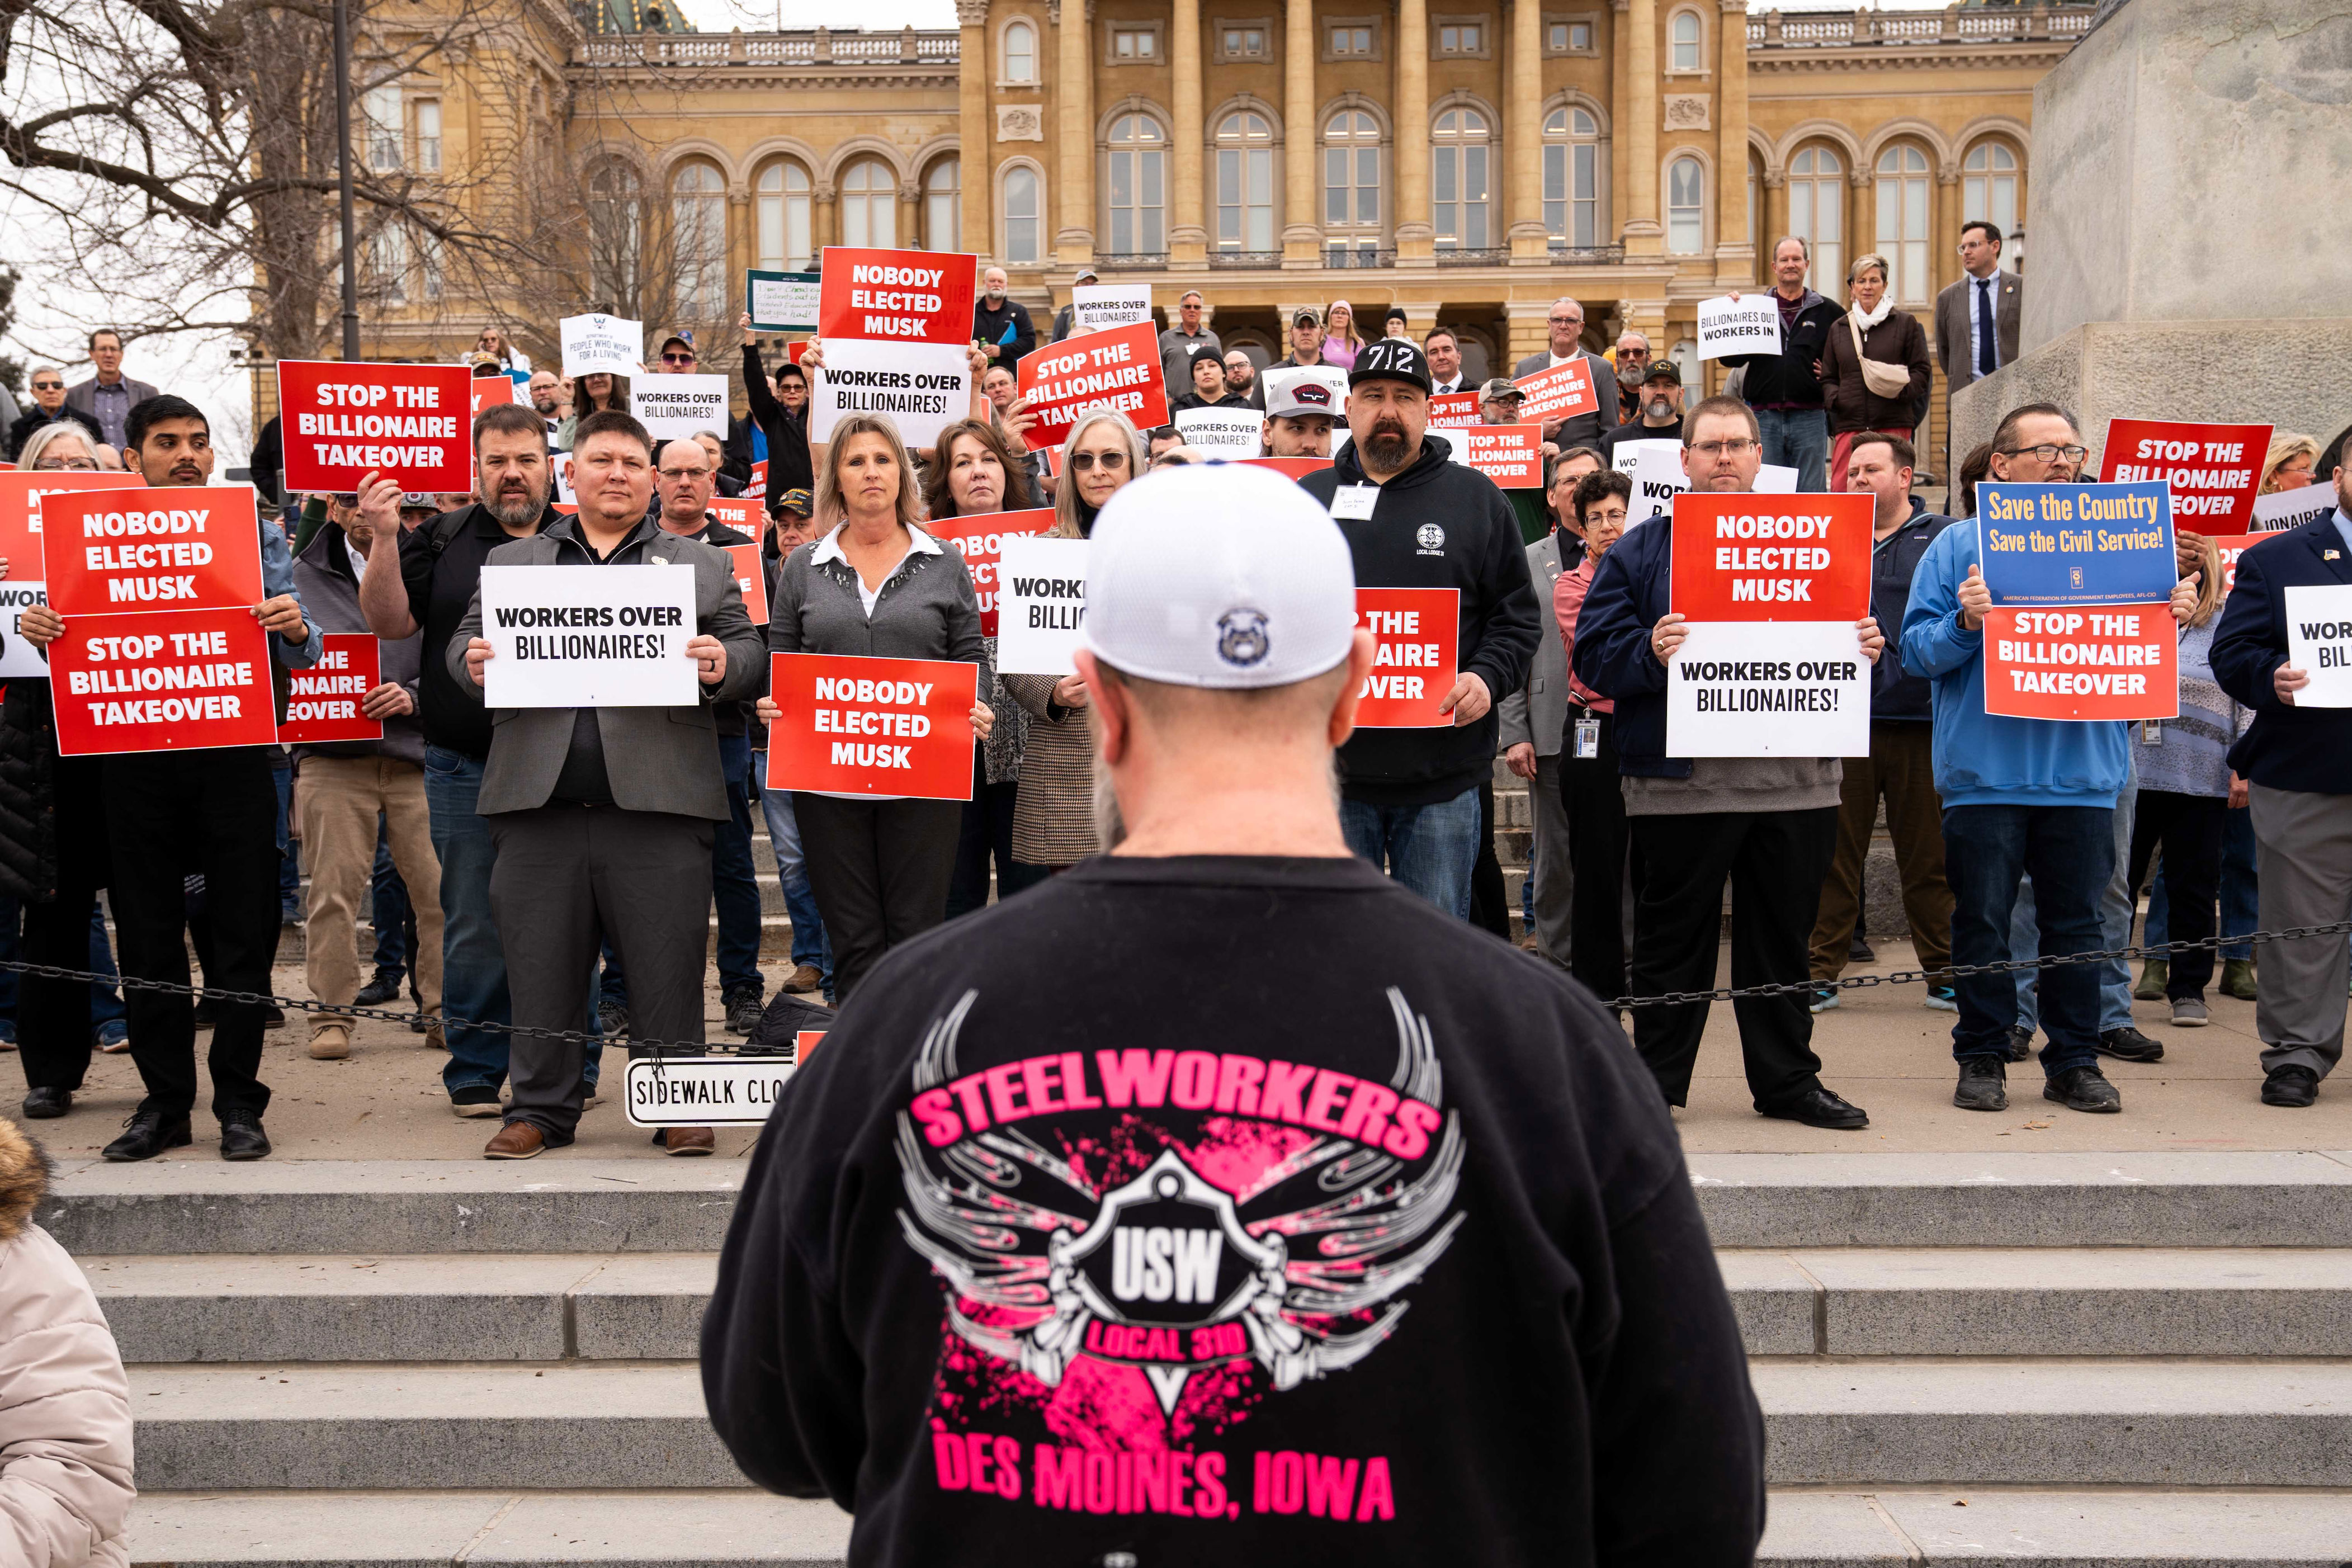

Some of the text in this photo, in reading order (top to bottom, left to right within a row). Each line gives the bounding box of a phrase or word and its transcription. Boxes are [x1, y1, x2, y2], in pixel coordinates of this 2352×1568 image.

[853, 265, 943, 287] NOBODY
[852, 290, 941, 312] ELECTED
[1079, 302, 1120, 310] WORKERS
[865, 315, 927, 336] MUSK
[1084, 311, 1140, 324] BILLIONAIRES!
[1701, 311, 1774, 328] BILLIONAIRES OUT
[1704, 326, 1773, 341] WORKERS IN
[570, 339, 631, 353] PEOPLE WHO WORK
[579, 350, 621, 361] FOR A LIVING
[1037, 343, 1131, 379] STOP THE
[825, 370, 961, 390] WORKERS OVER
[1026, 363, 1150, 405] BILLIONAIRE
[1518, 370, 1574, 394] STOP THE
[318, 384, 438, 408] STOP THE
[637, 394, 721, 403] WORKERS OVER
[837, 391, 946, 413] BILLIONAIRES!
[1519, 393, 1582, 418] TAKEOVER
[646, 407, 713, 418] BILLIONAIRES!
[1432, 402, 1472, 415] OP THE
[299, 414, 456, 437] BILLIONAIRE
[1181, 424, 1227, 432] WORKERS
[1427, 414, 1482, 427] LIONAIRE
[1186, 434, 1250, 446] BILLIONAIRES!
[1469, 434, 1524, 447] TOP THE
[2137, 440, 2199, 461] STOP
[2205, 443, 2243, 462] THE
[314, 444, 443, 467] TAKEOVER
[1469, 449, 1534, 462] LIONAIRE
[750, 471, 763, 485] HE
[1471, 465, 1527, 476] KEOVER
[719, 509, 746, 521] THE
[1989, 492, 2158, 524] Save the Country
[2171, 495, 2235, 516] EOVER
[83, 510, 209, 537] NOBODY
[1717, 516, 1832, 538] NOBODY
[1990, 527, 2163, 552] Save the Civil Service!
[86, 542, 212, 570] ELECTED
[1716, 547, 1830, 570] ELECTED
[108, 575, 198, 602] MUSK
[1013, 578, 1086, 598] WORK
[1732, 579, 1812, 601] MUSK
[495, 607, 682, 627] WORKERS OVER
[1366, 611, 1419, 634] THE
[2015, 612, 2139, 636] STOP THE
[87, 632, 228, 661] STOP THE
[516, 635, 664, 659] BILLIONAIRES!
[1999, 640, 2160, 665] BILLIONAIRE
[309, 651, 348, 669] HE
[69, 663, 253, 694] BILLIONAIRE
[1680, 662, 1857, 681] WORKERS OVER
[2010, 670, 2146, 695] TAKEOVER
[816, 678, 933, 705] NOBODY
[1357, 676, 1424, 699] OVER
[88, 696, 241, 725] TAKEOVER
[1698, 688, 1838, 711] BILLIONAIRES!
[287, 701, 356, 721] EOVER
[815, 710, 930, 737] ELECTED
[832, 742, 911, 768] MUSK
[636, 1079, 782, 1105] SIDEWALK CLO
[911, 1049, 1442, 1161] STEELWORKERS
[1112, 1227, 1224, 1302] USW
[1085, 1320, 1247, 1361] LOCAL 310
[932, 1432, 1395, 1522] DES MOINES, IOWA
